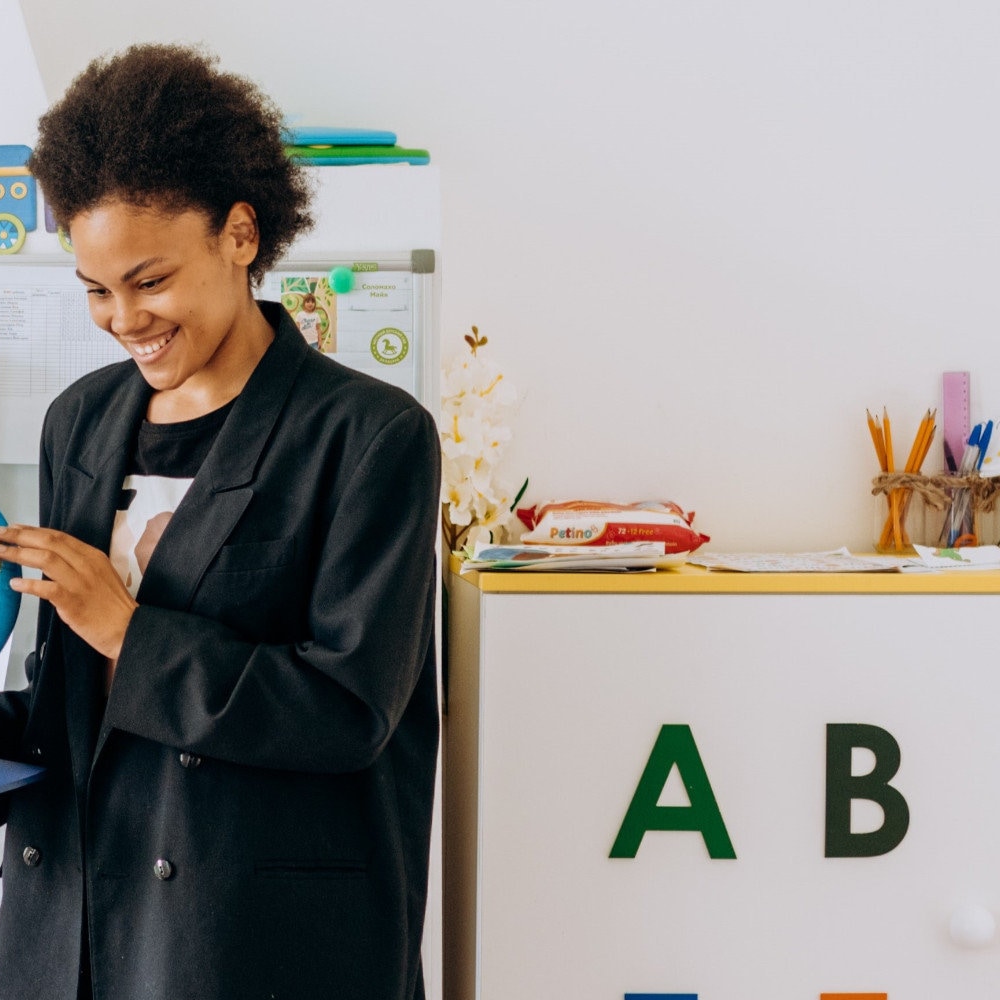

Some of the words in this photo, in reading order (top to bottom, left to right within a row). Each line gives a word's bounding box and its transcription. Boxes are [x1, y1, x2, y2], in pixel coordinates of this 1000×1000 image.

[550, 527, 593, 539] Petino
[608, 724, 738, 860] A
[824, 723, 910, 858] B
